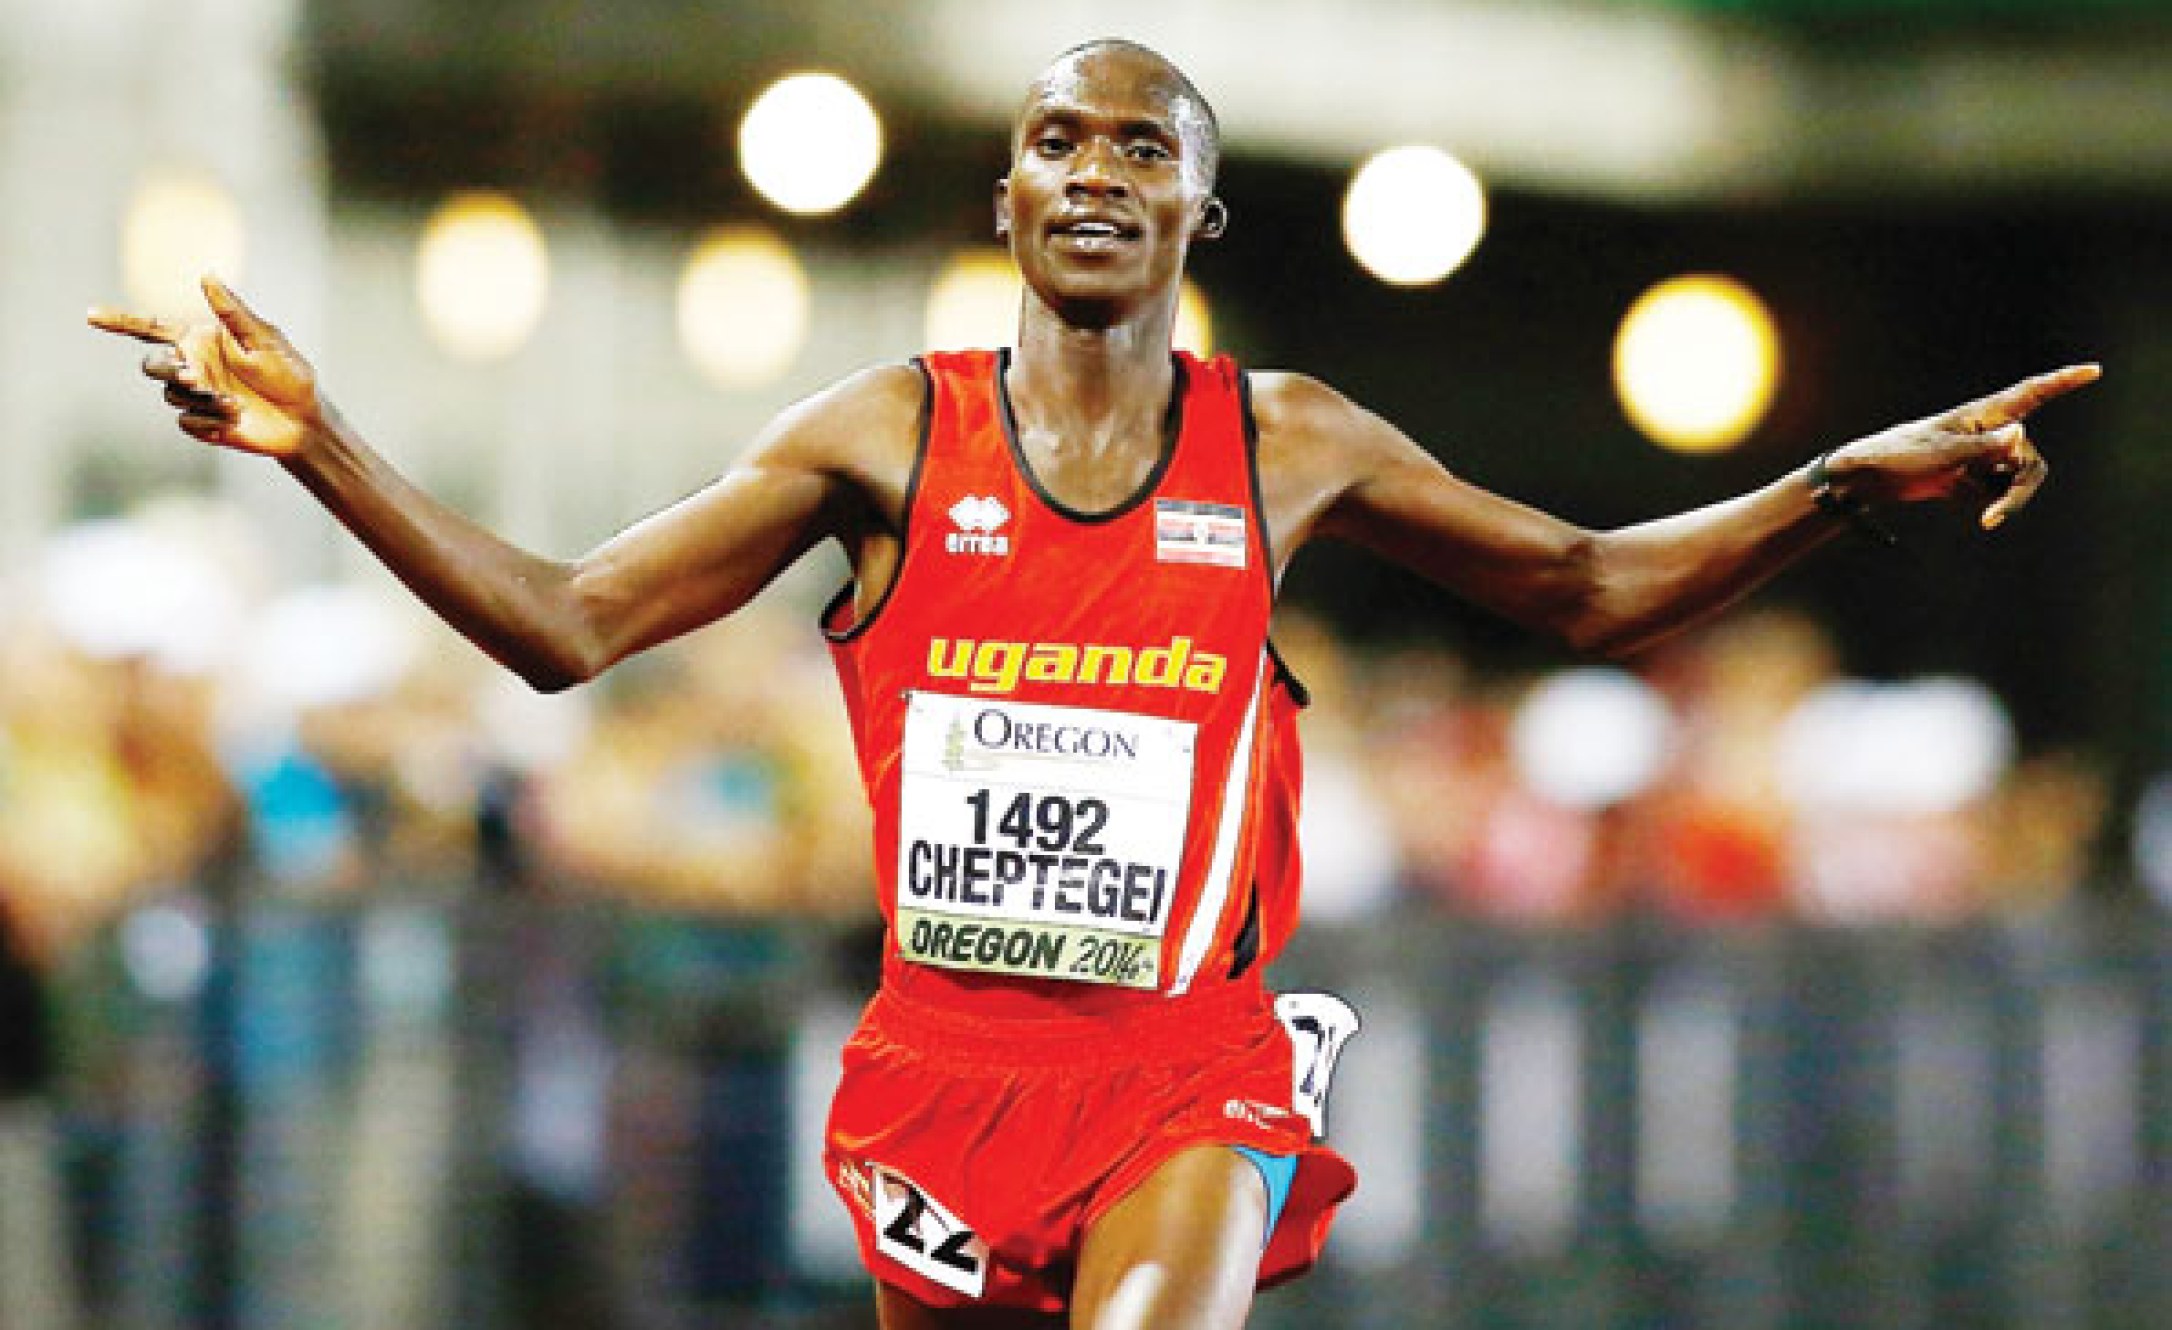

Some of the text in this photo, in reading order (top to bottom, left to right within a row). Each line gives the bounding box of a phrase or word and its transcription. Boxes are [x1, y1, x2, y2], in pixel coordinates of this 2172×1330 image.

[926, 635, 1228, 694] uganda
[974, 708, 1139, 759] OREGON
[965, 788, 1110, 855] 1492
[908, 840, 1168, 923] CHEPTEGEI
[911, 919, 1067, 970] OREGON
